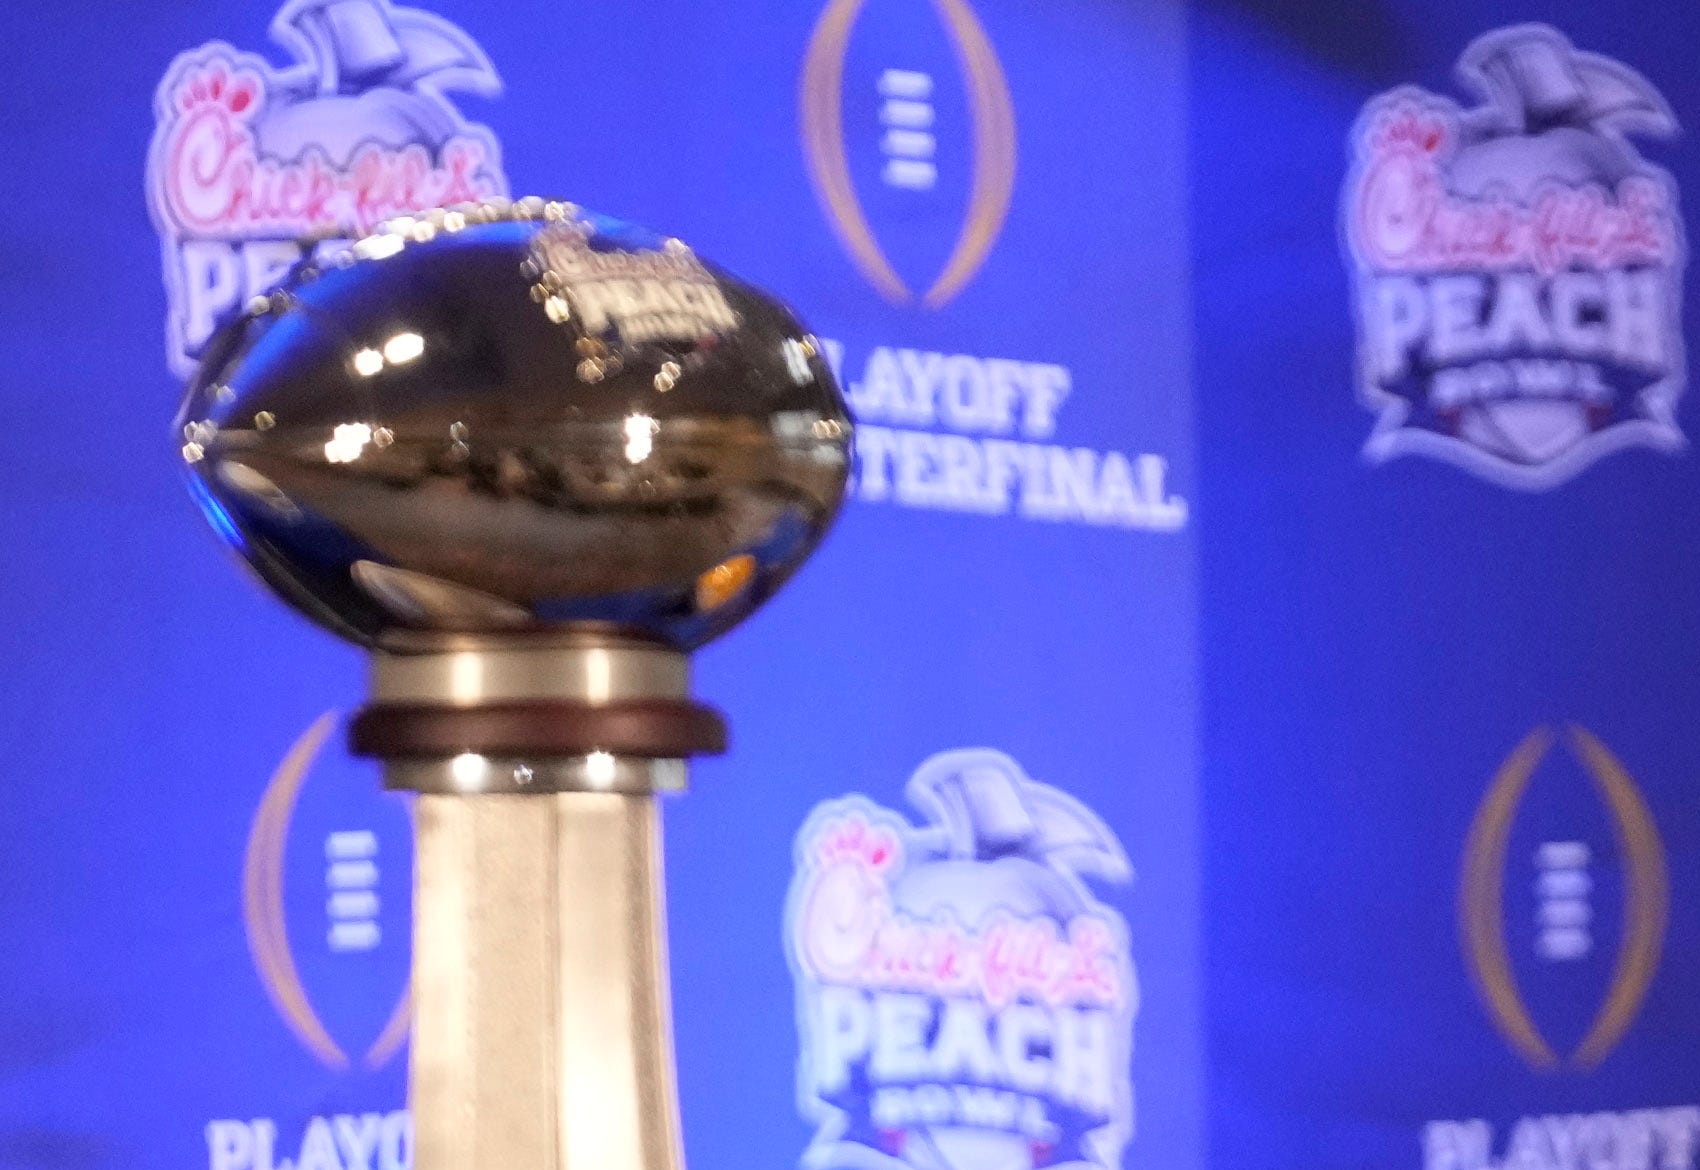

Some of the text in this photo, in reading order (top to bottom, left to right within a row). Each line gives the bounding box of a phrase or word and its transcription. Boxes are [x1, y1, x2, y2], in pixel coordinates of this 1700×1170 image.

[1368, 272, 1666, 375] PEACH
[820, 339, 1072, 438] LAYOFF
[855, 424, 1188, 534] TERFINAL
[818, 988, 1117, 1110] PEACH
